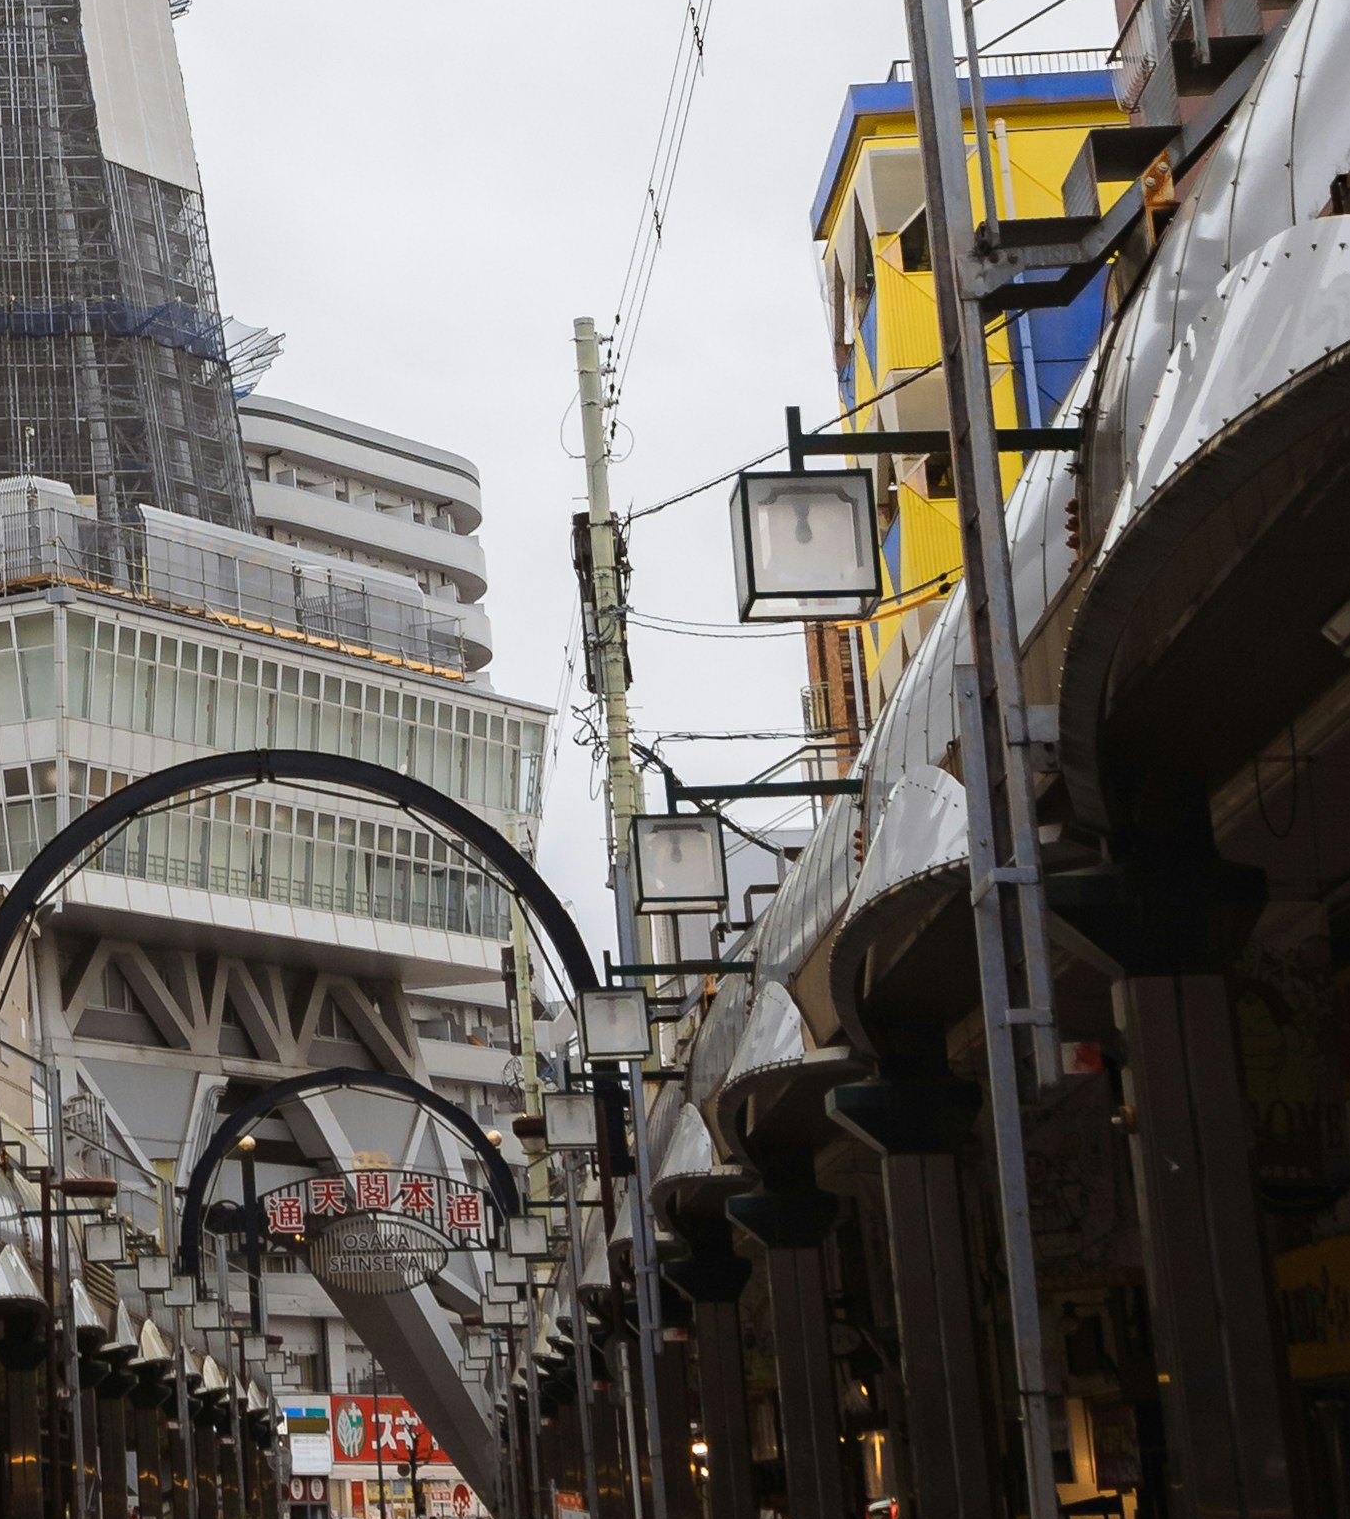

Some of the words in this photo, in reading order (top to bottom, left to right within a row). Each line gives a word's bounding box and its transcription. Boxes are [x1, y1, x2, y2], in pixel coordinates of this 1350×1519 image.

[267, 1172, 482, 1234] 通天閣本通
[342, 1233, 411, 1250] OSAKA
[328, 1255, 428, 1274] SHINSEKAI
